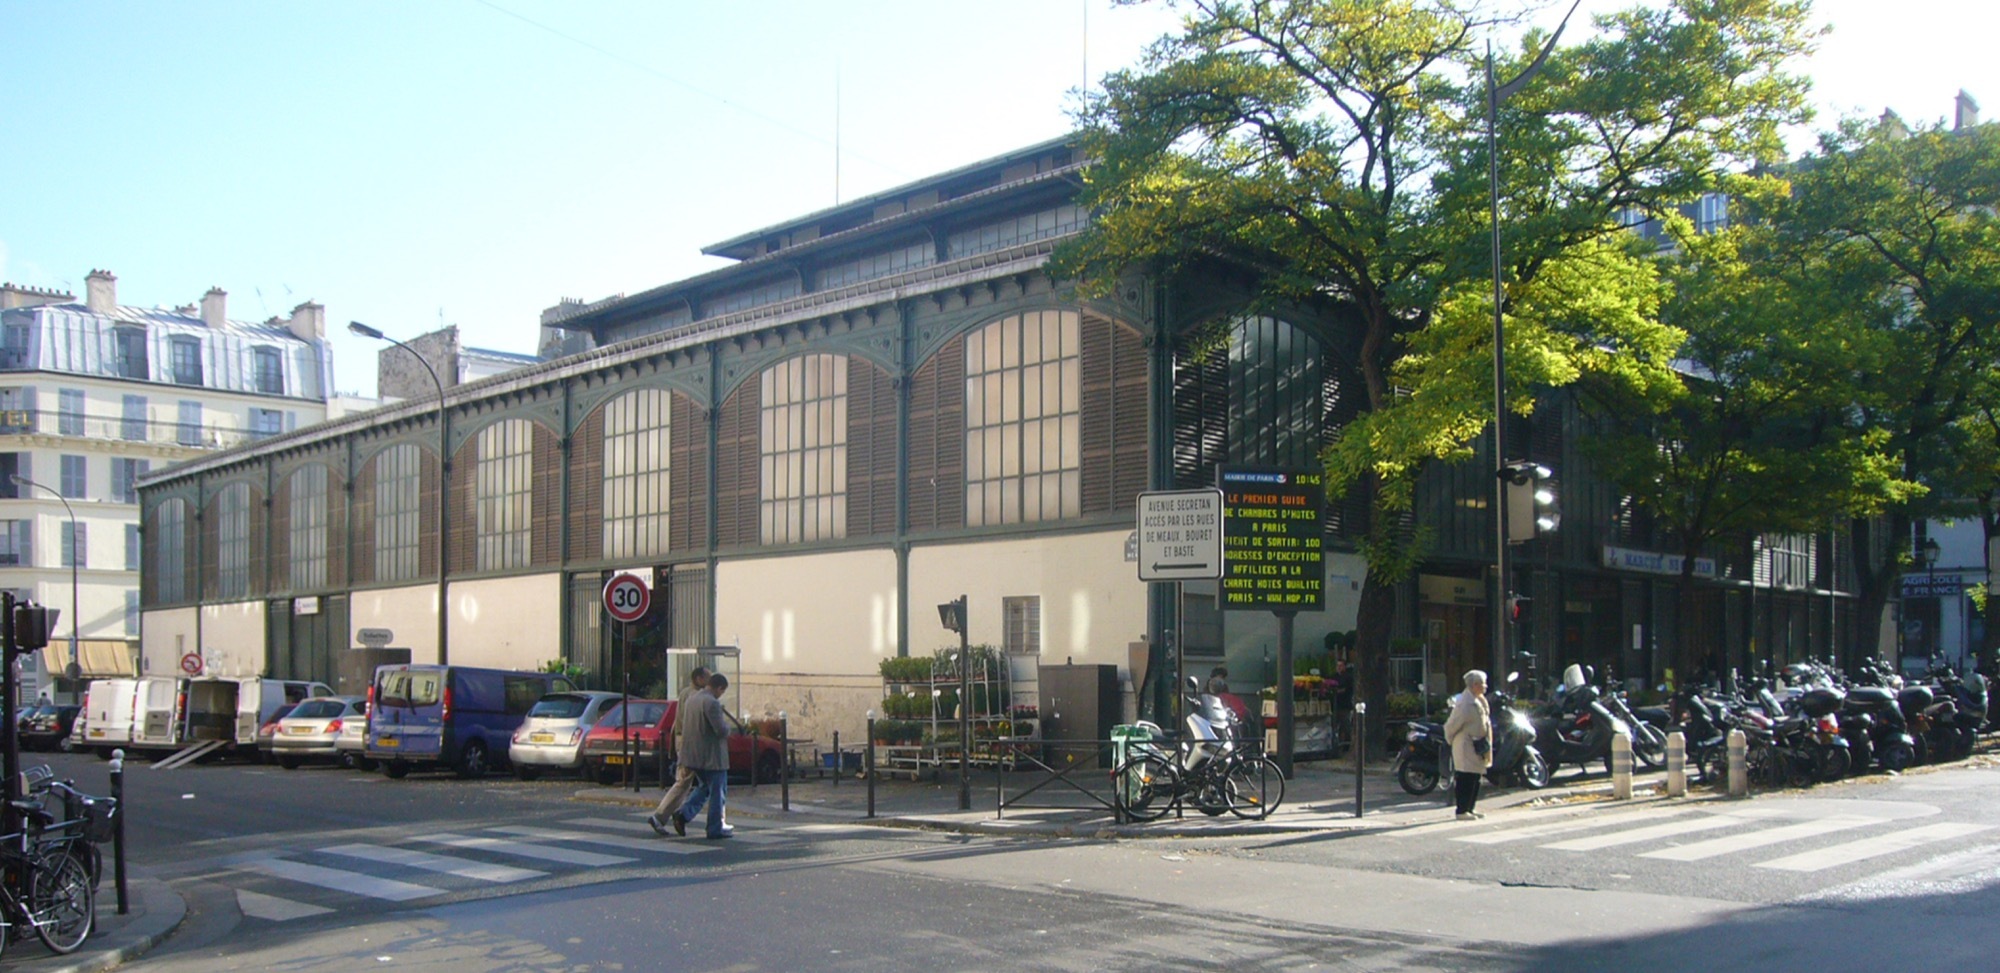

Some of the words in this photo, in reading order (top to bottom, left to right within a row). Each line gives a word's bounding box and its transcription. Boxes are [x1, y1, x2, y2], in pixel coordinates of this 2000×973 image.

[1247, 474, 1256, 482] DE
[1296, 475, 1320, 485] 10:45
[1228, 494, 1238, 504] LE
[1243, 495, 1277, 504] PREMIER
[1282, 496, 1306, 505] GUIDE
[1148, 501, 1175, 512] AVENUE
[1224, 508, 1234, 517] DE
[1238, 508, 1277, 518] CHAMBRES
[1167, 516, 1180, 526] PAR
[1182, 515, 1195, 526] LES
[1196, 514, 1214, 525] RUES
[1262, 523, 1287, 533] PARIS
[1146, 531, 1155, 542] DE
[1186, 529, 1212, 541] BOURET
[1252, 538, 1262, 547] DE
[1305, 538, 1320, 548] 100
[1164, 547, 1172, 557] ET
[1174, 546, 1195, 557] BASTE
[1233, 565, 1277, 575] AFFILIEES
[1291, 566, 1301, 575] LA
[1224, 579, 1253, 589] CHARTE
[614, 587, 641, 608] 30
[1228, 593, 1253, 602] PARIS
